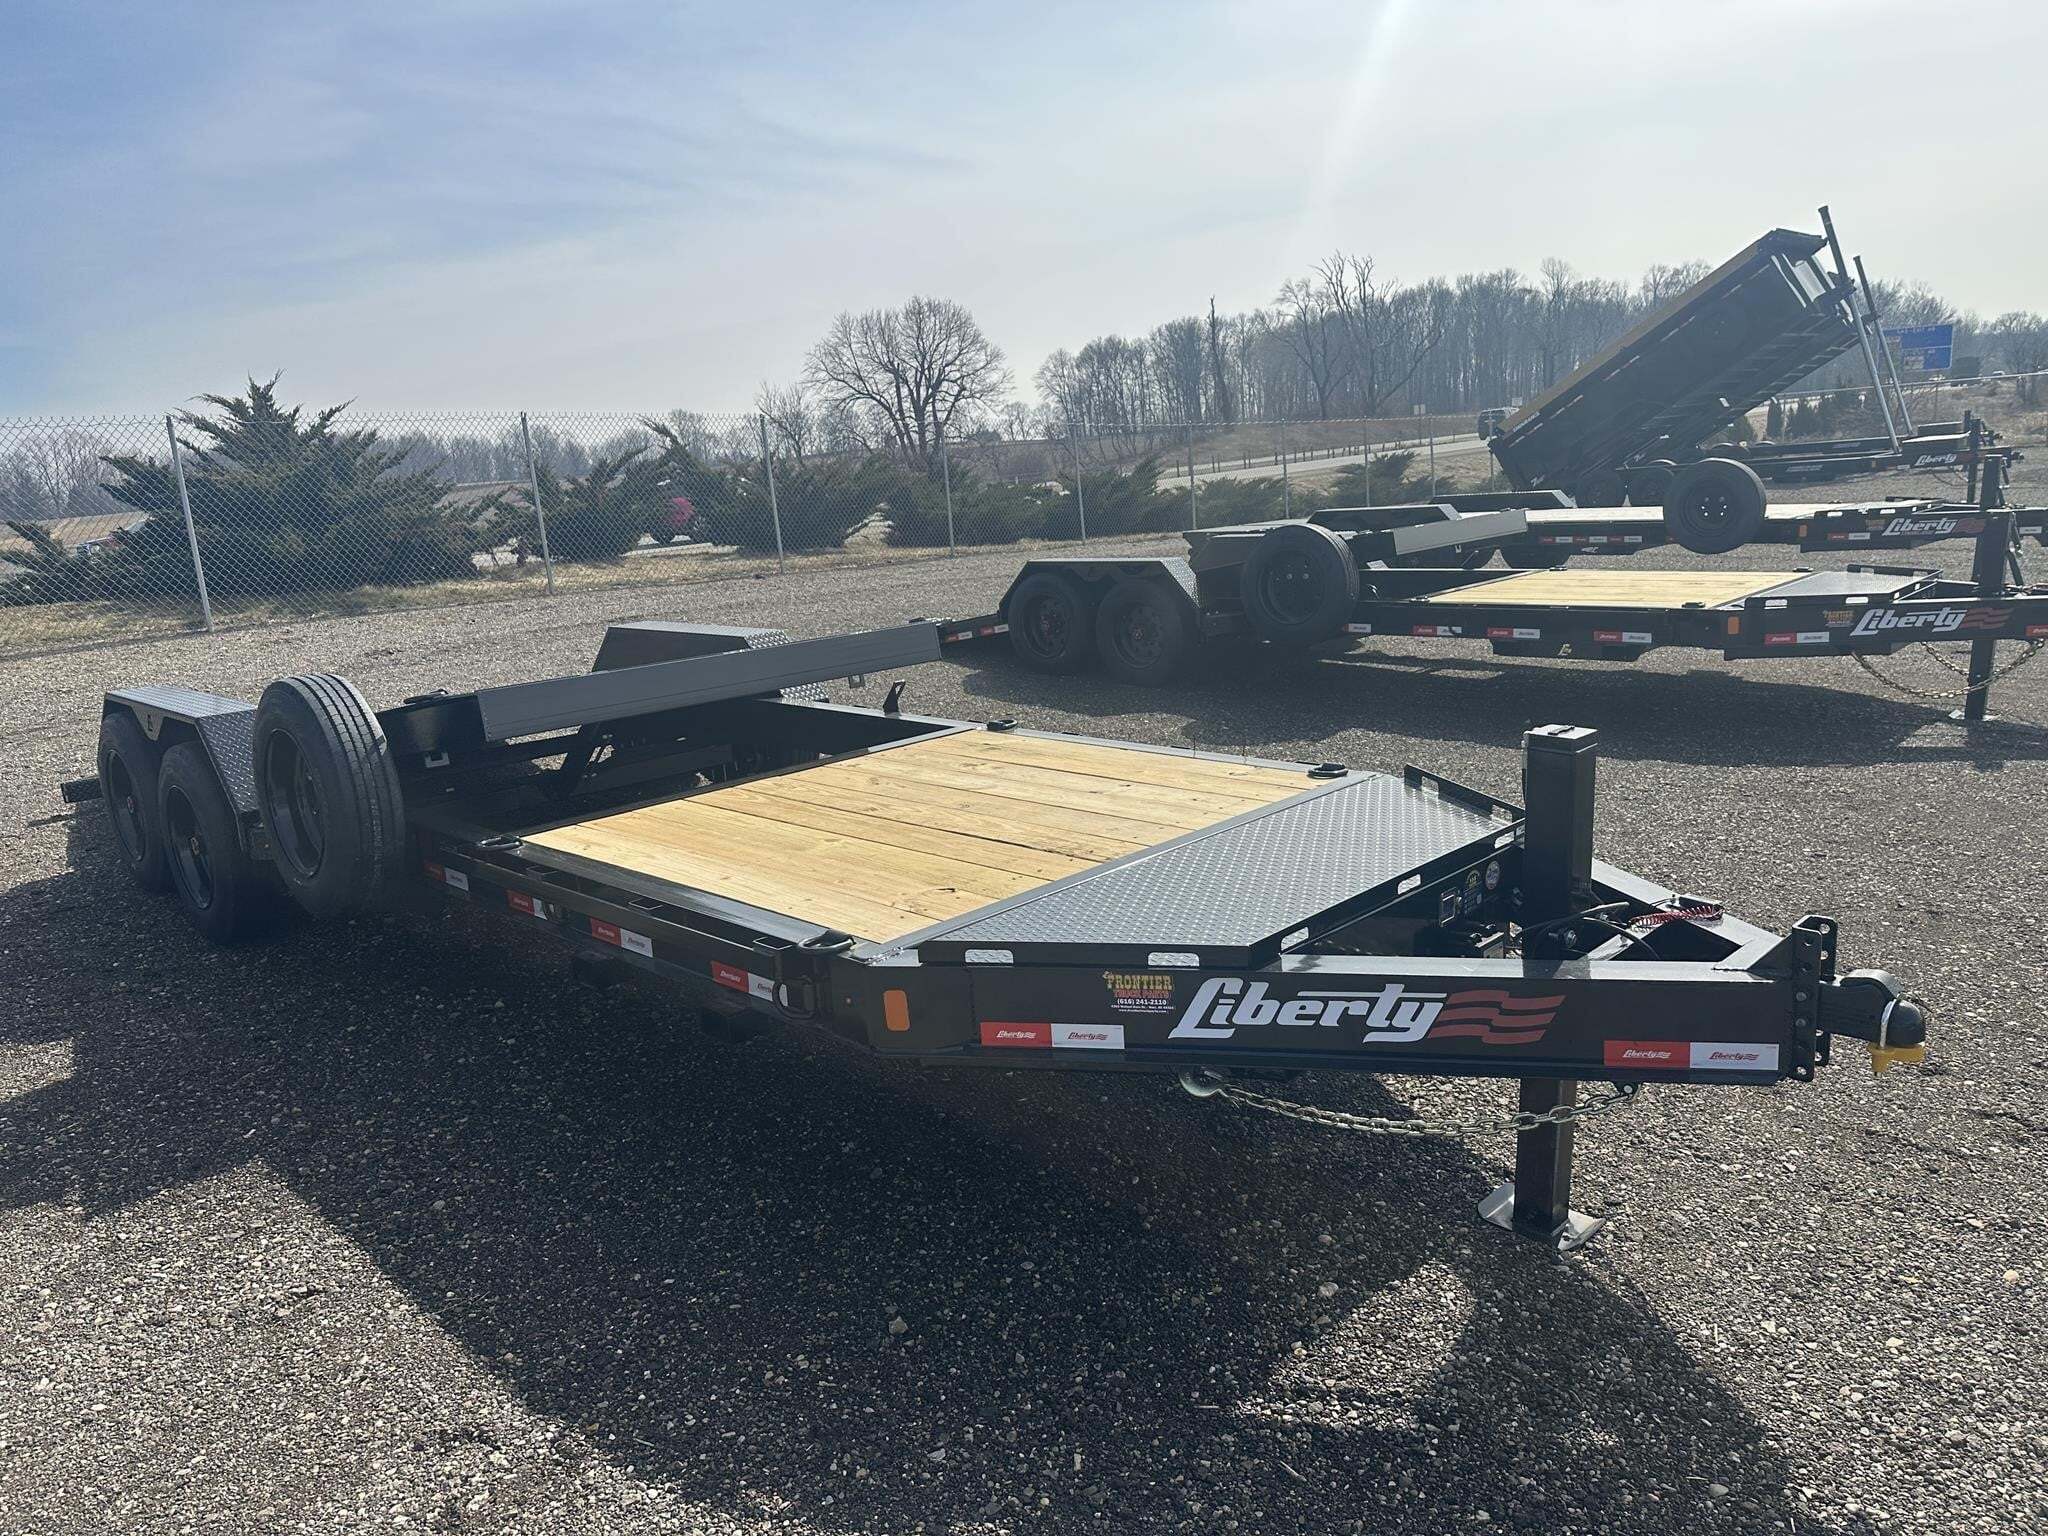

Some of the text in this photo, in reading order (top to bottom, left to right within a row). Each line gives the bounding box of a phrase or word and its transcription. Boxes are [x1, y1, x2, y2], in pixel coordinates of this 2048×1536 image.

[1915, 453, 1957, 466] Liberty
[1882, 517, 1958, 536] Liberty
[1850, 606, 1967, 636] Liberty
[1107, 974, 1173, 990] FRONTIER
[1168, 977, 1447, 1044] Liberty
[996, 1030, 1026, 1039] Liberty
[1622, 1049, 1657, 1058] Liberty
[1709, 1051, 1743, 1060] Liberty
